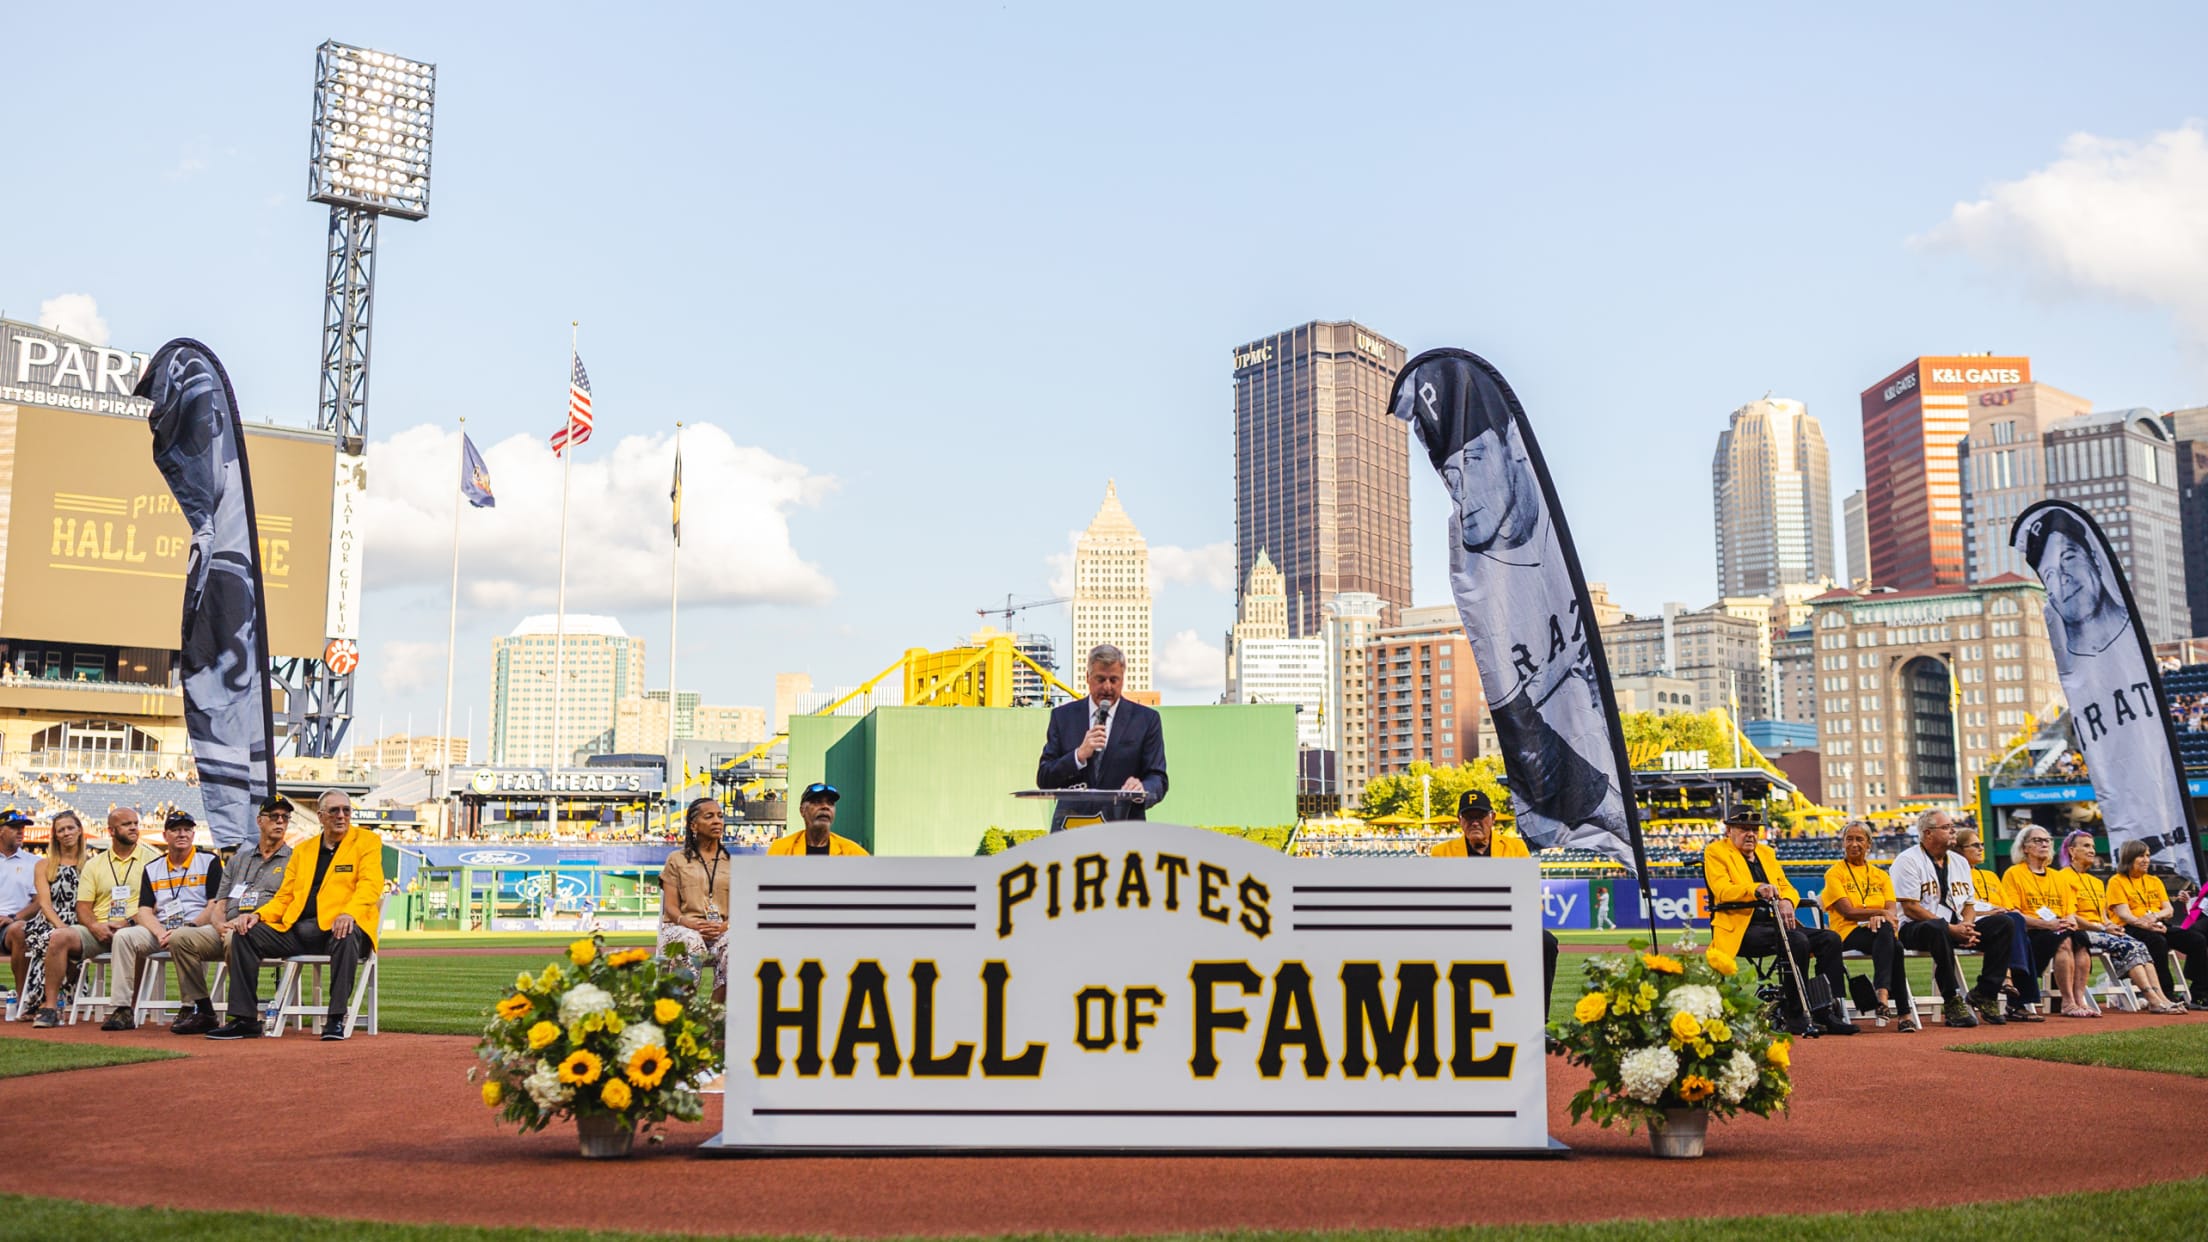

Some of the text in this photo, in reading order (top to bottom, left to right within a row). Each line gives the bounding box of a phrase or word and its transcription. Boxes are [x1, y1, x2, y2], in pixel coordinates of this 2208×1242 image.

[1234, 345, 1273, 371] UPMC
[1356, 332, 1386, 360] UPMC
[1932, 368, 2021, 384] K&L GATES
[0, 386, 94, 411] TTSBURGH
[1979, 388, 2017, 407] EQT
[132, 494, 181, 519] PIRA
[51, 517, 185, 563] HALL OF
[1661, 750, 1709, 770] TIME
[502, 774, 641, 792] FAT HEAD'S
[1469, 793, 1478, 805] P
[470, 852, 518, 864] Ford
[996, 851, 1272, 940] PIRATES
[752, 959, 1518, 1080] HALL OF FAME
